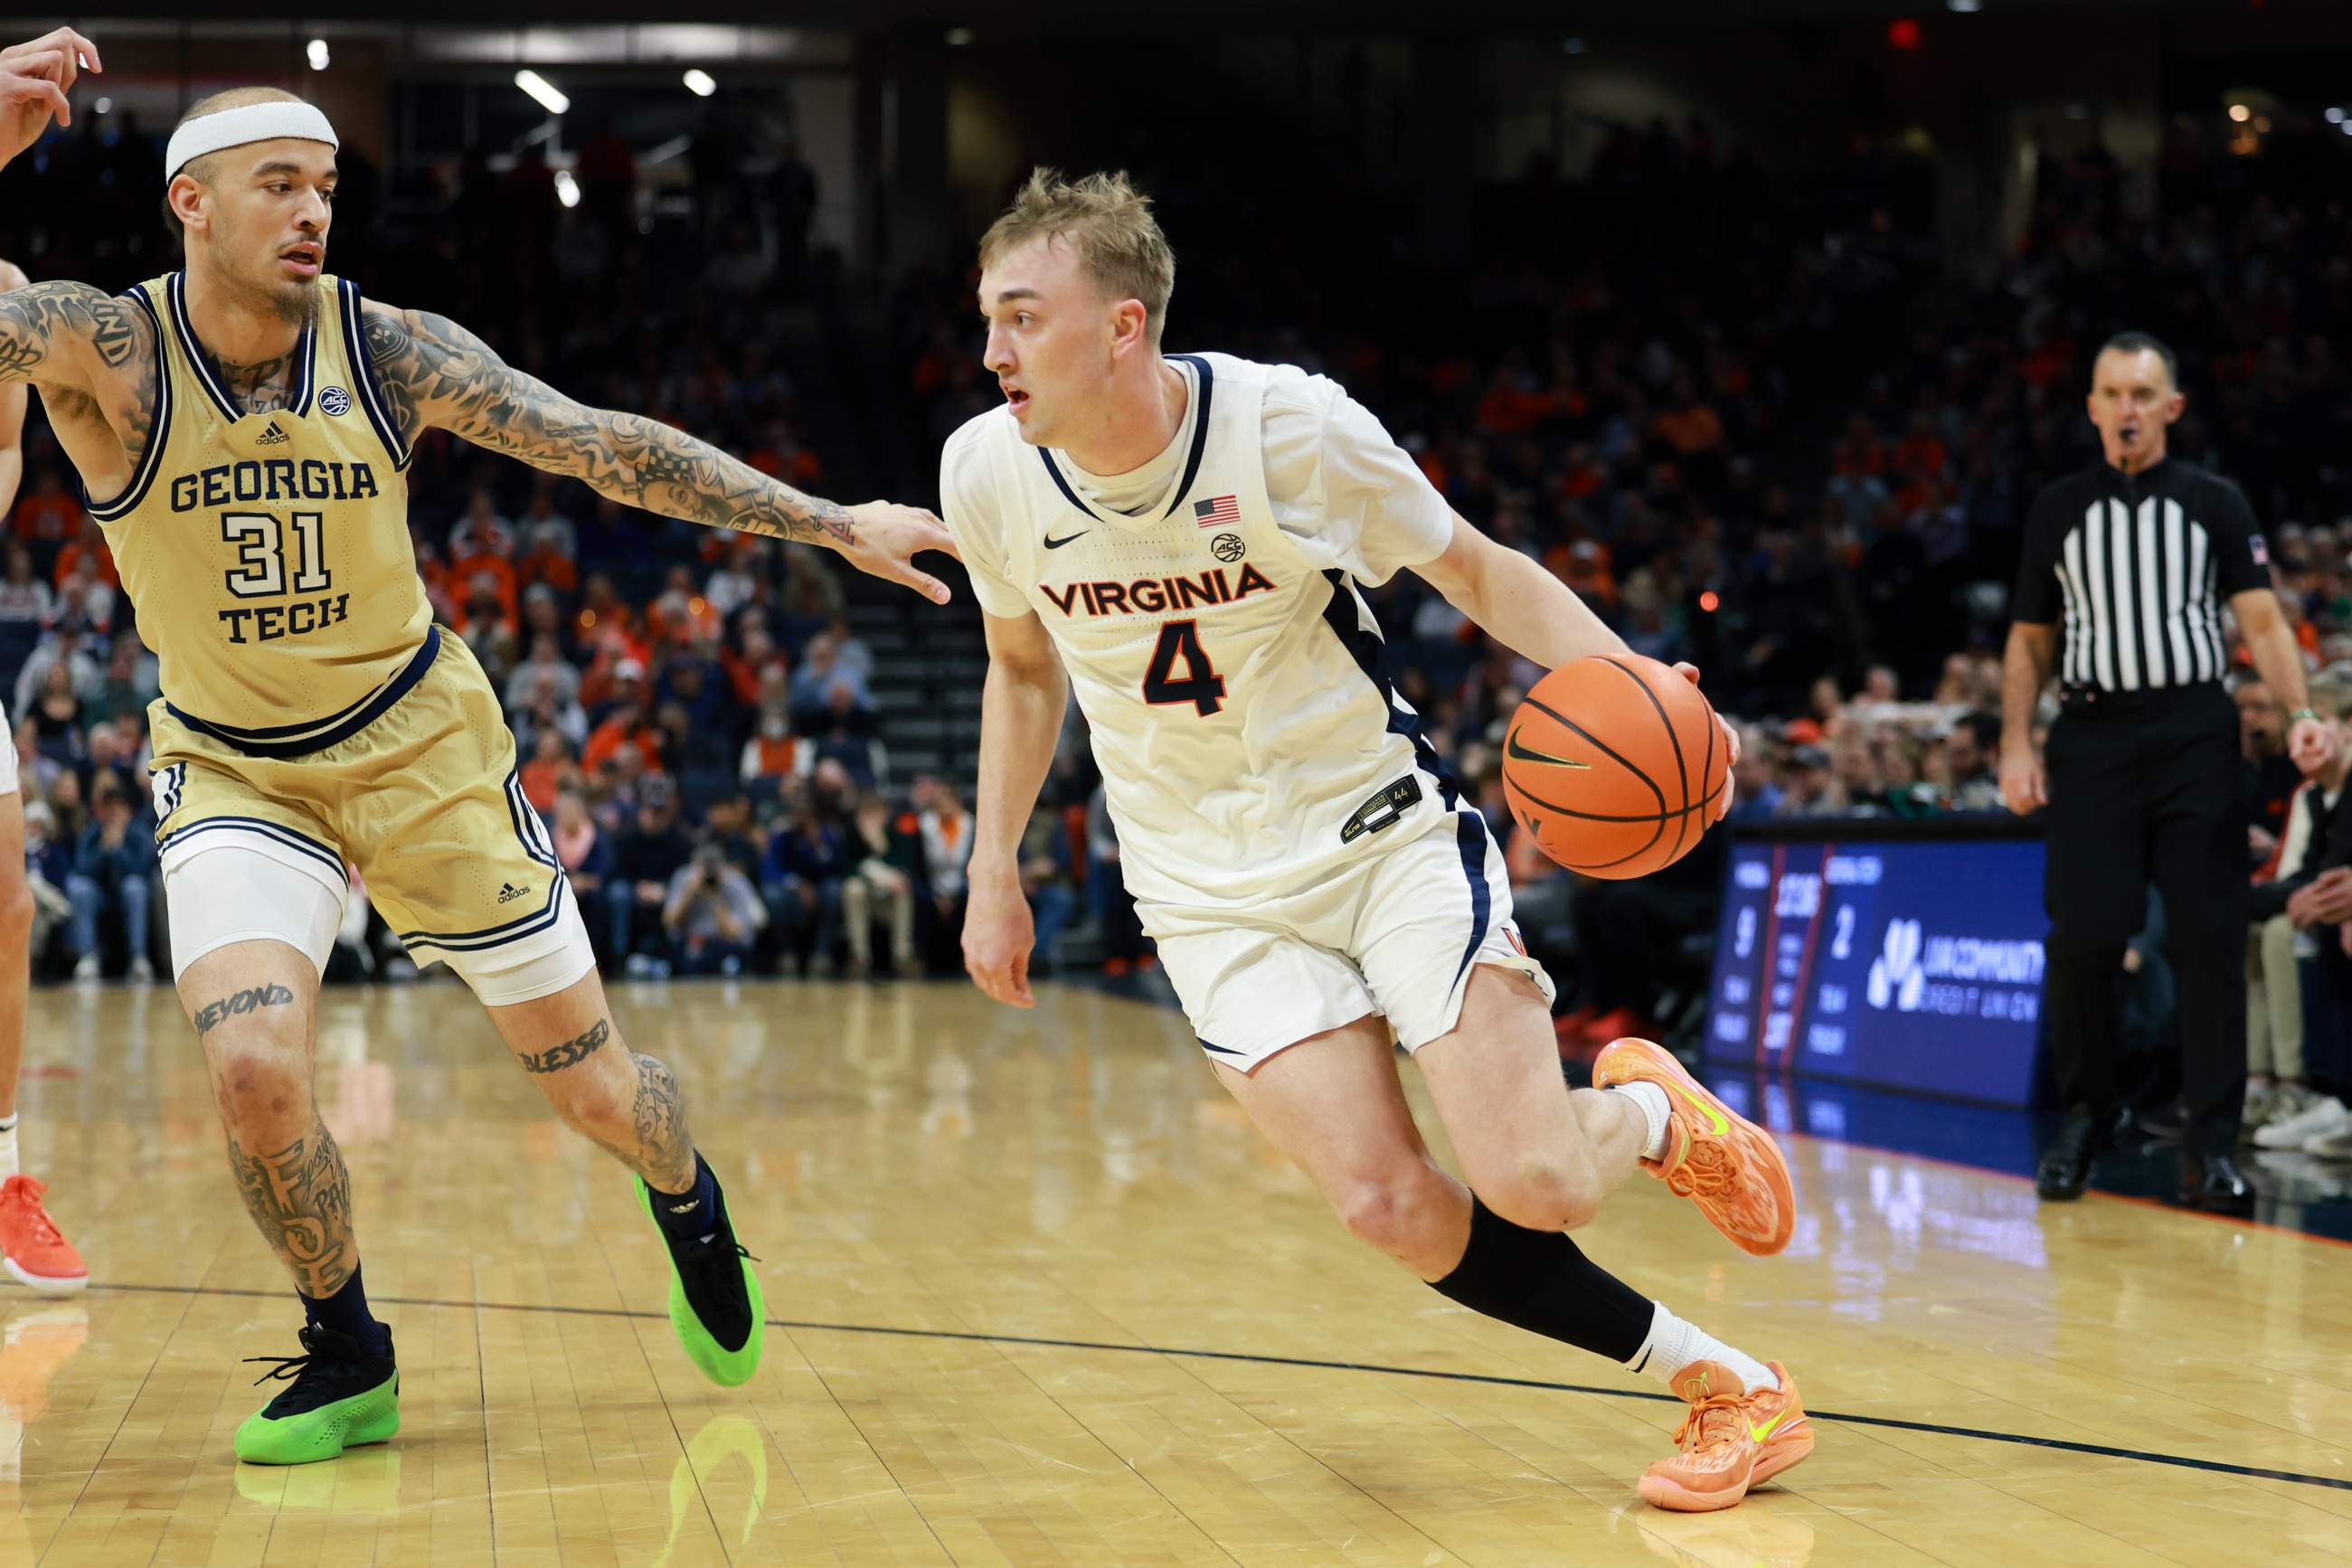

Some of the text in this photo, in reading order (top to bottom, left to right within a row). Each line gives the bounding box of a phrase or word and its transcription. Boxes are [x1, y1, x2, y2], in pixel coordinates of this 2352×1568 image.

[255, 433, 290, 445] adidas
[171, 459, 378, 513] GEORGIA
[221, 511, 331, 599] 31
[1038, 562, 1278, 618] VIRGINIA
[219, 593, 349, 644] TECH
[1141, 619, 1228, 718] 4
[1393, 787, 1409, 801] 44
[497, 886, 531, 903] adidas
[1831, 903, 1856, 960] 2
[194, 982, 294, 1040] BEYOND
[517, 1018, 609, 1074] BLESSED
